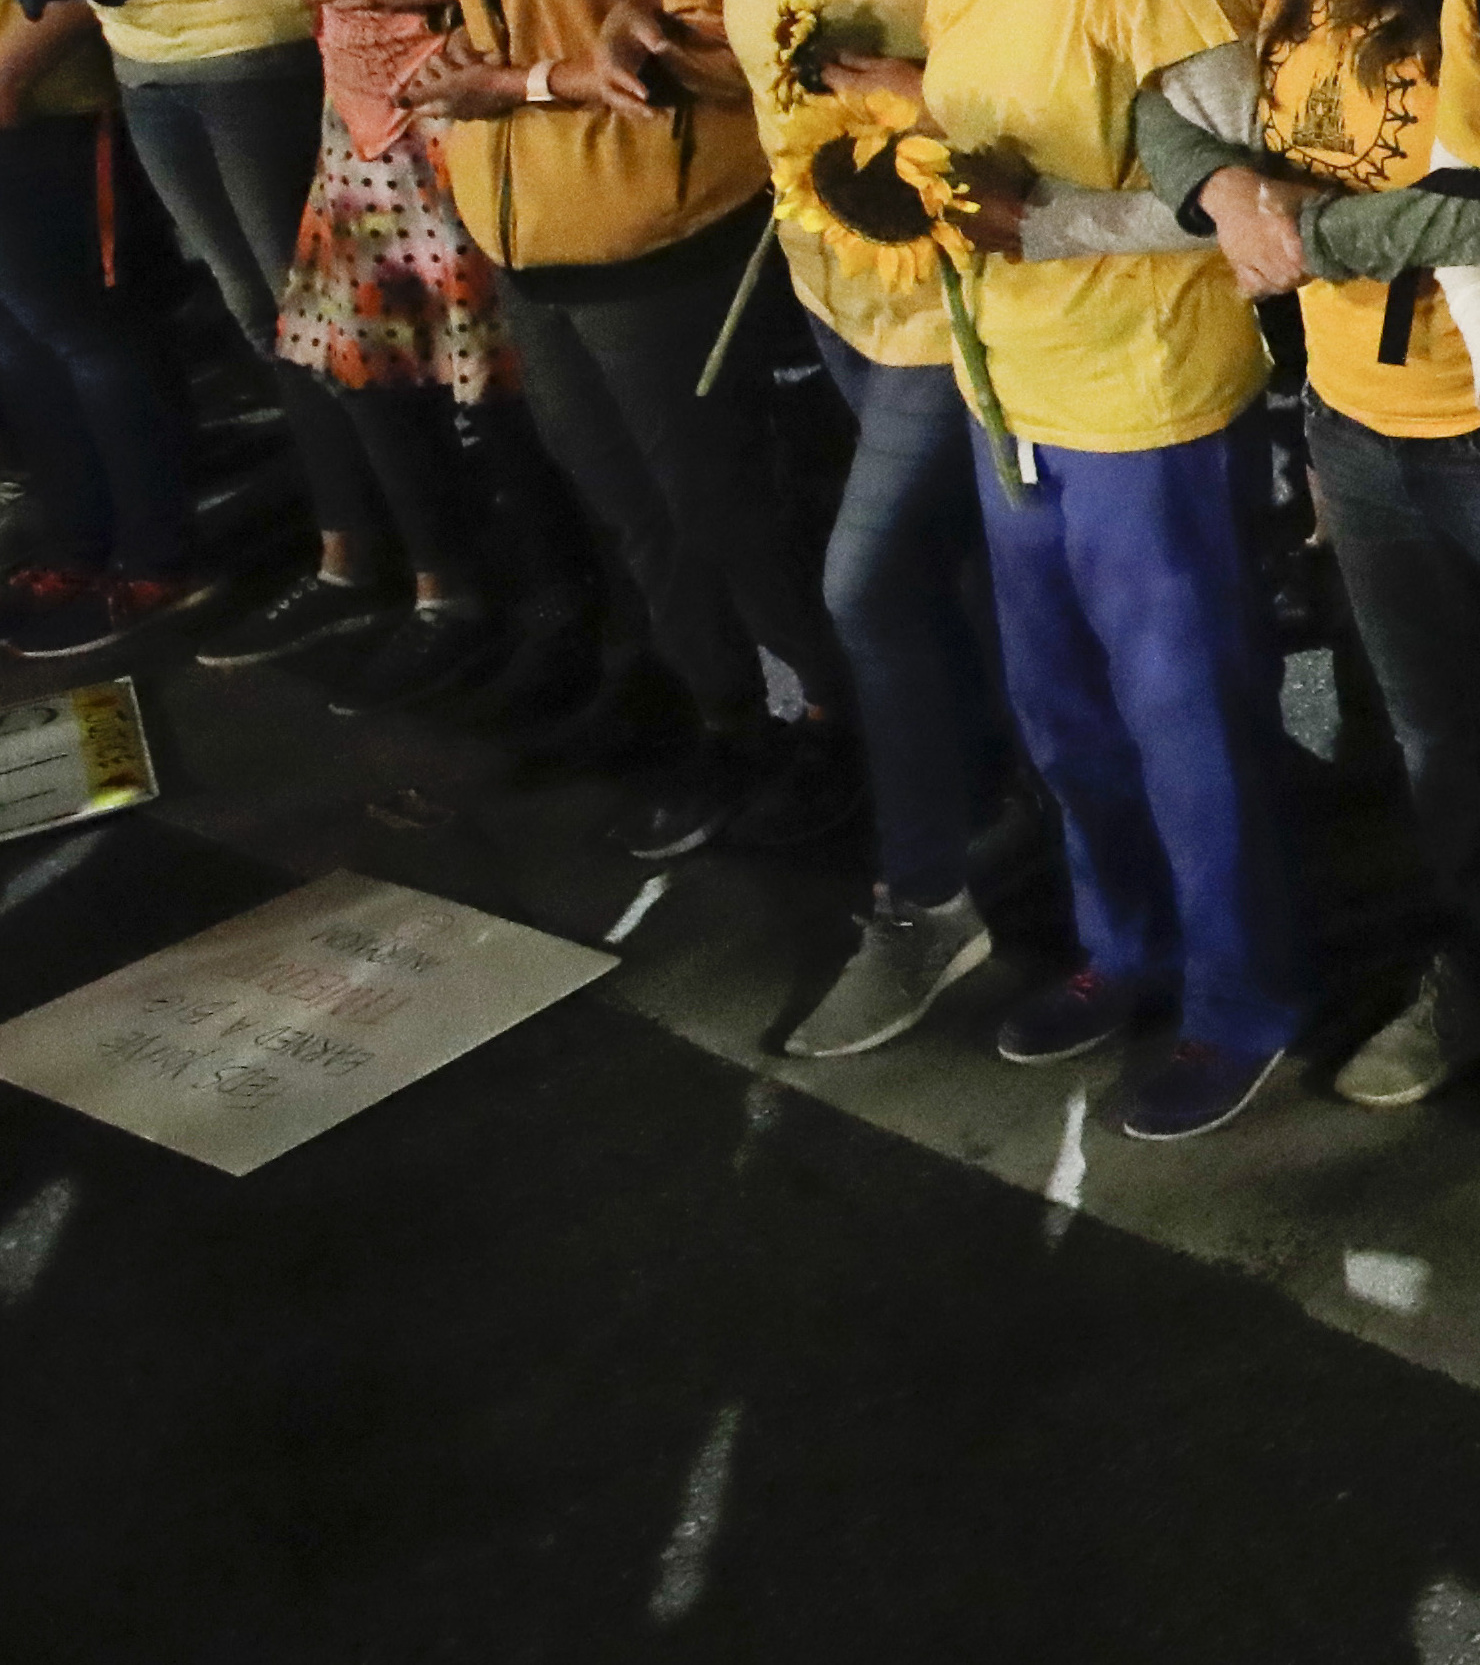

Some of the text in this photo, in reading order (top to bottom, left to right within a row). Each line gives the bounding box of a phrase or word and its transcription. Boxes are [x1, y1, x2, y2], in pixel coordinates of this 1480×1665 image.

[142, 995, 376, 1078] EARNED A BIG
